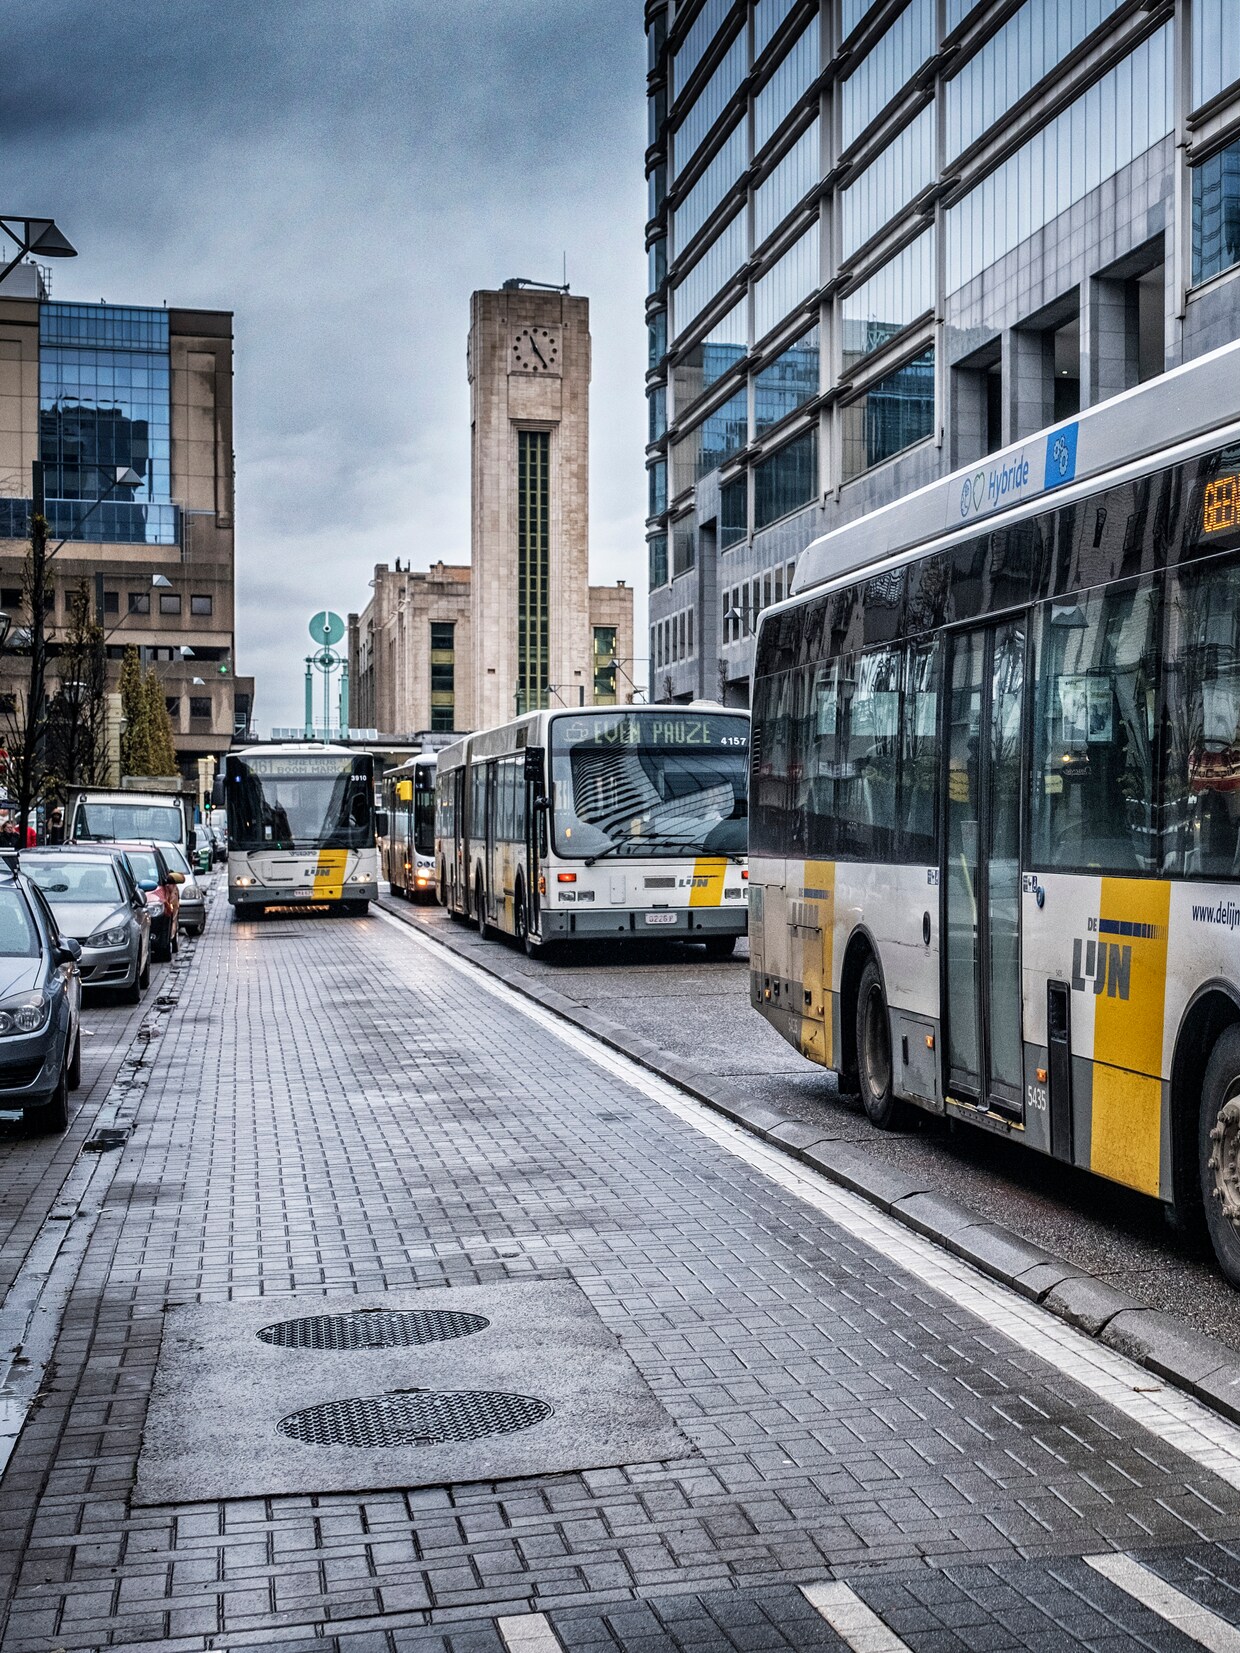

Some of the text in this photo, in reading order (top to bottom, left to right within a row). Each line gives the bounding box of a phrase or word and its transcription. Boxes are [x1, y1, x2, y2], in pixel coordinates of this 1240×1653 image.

[987, 454, 1029, 507] Hybride
[594, 721, 712, 744] EVEN PAUZE
[721, 737, 747, 746] 4157
[250, 759, 272, 774] 461
[277, 766, 306, 774] BOOM
[351, 774, 367, 782] 3910
[679, 879, 708, 888] LIJN
[1087, 917, 1098, 932] DE
[1071, 938, 1132, 1001] LIJN
[1028, 1085, 1047, 1111] 5435
